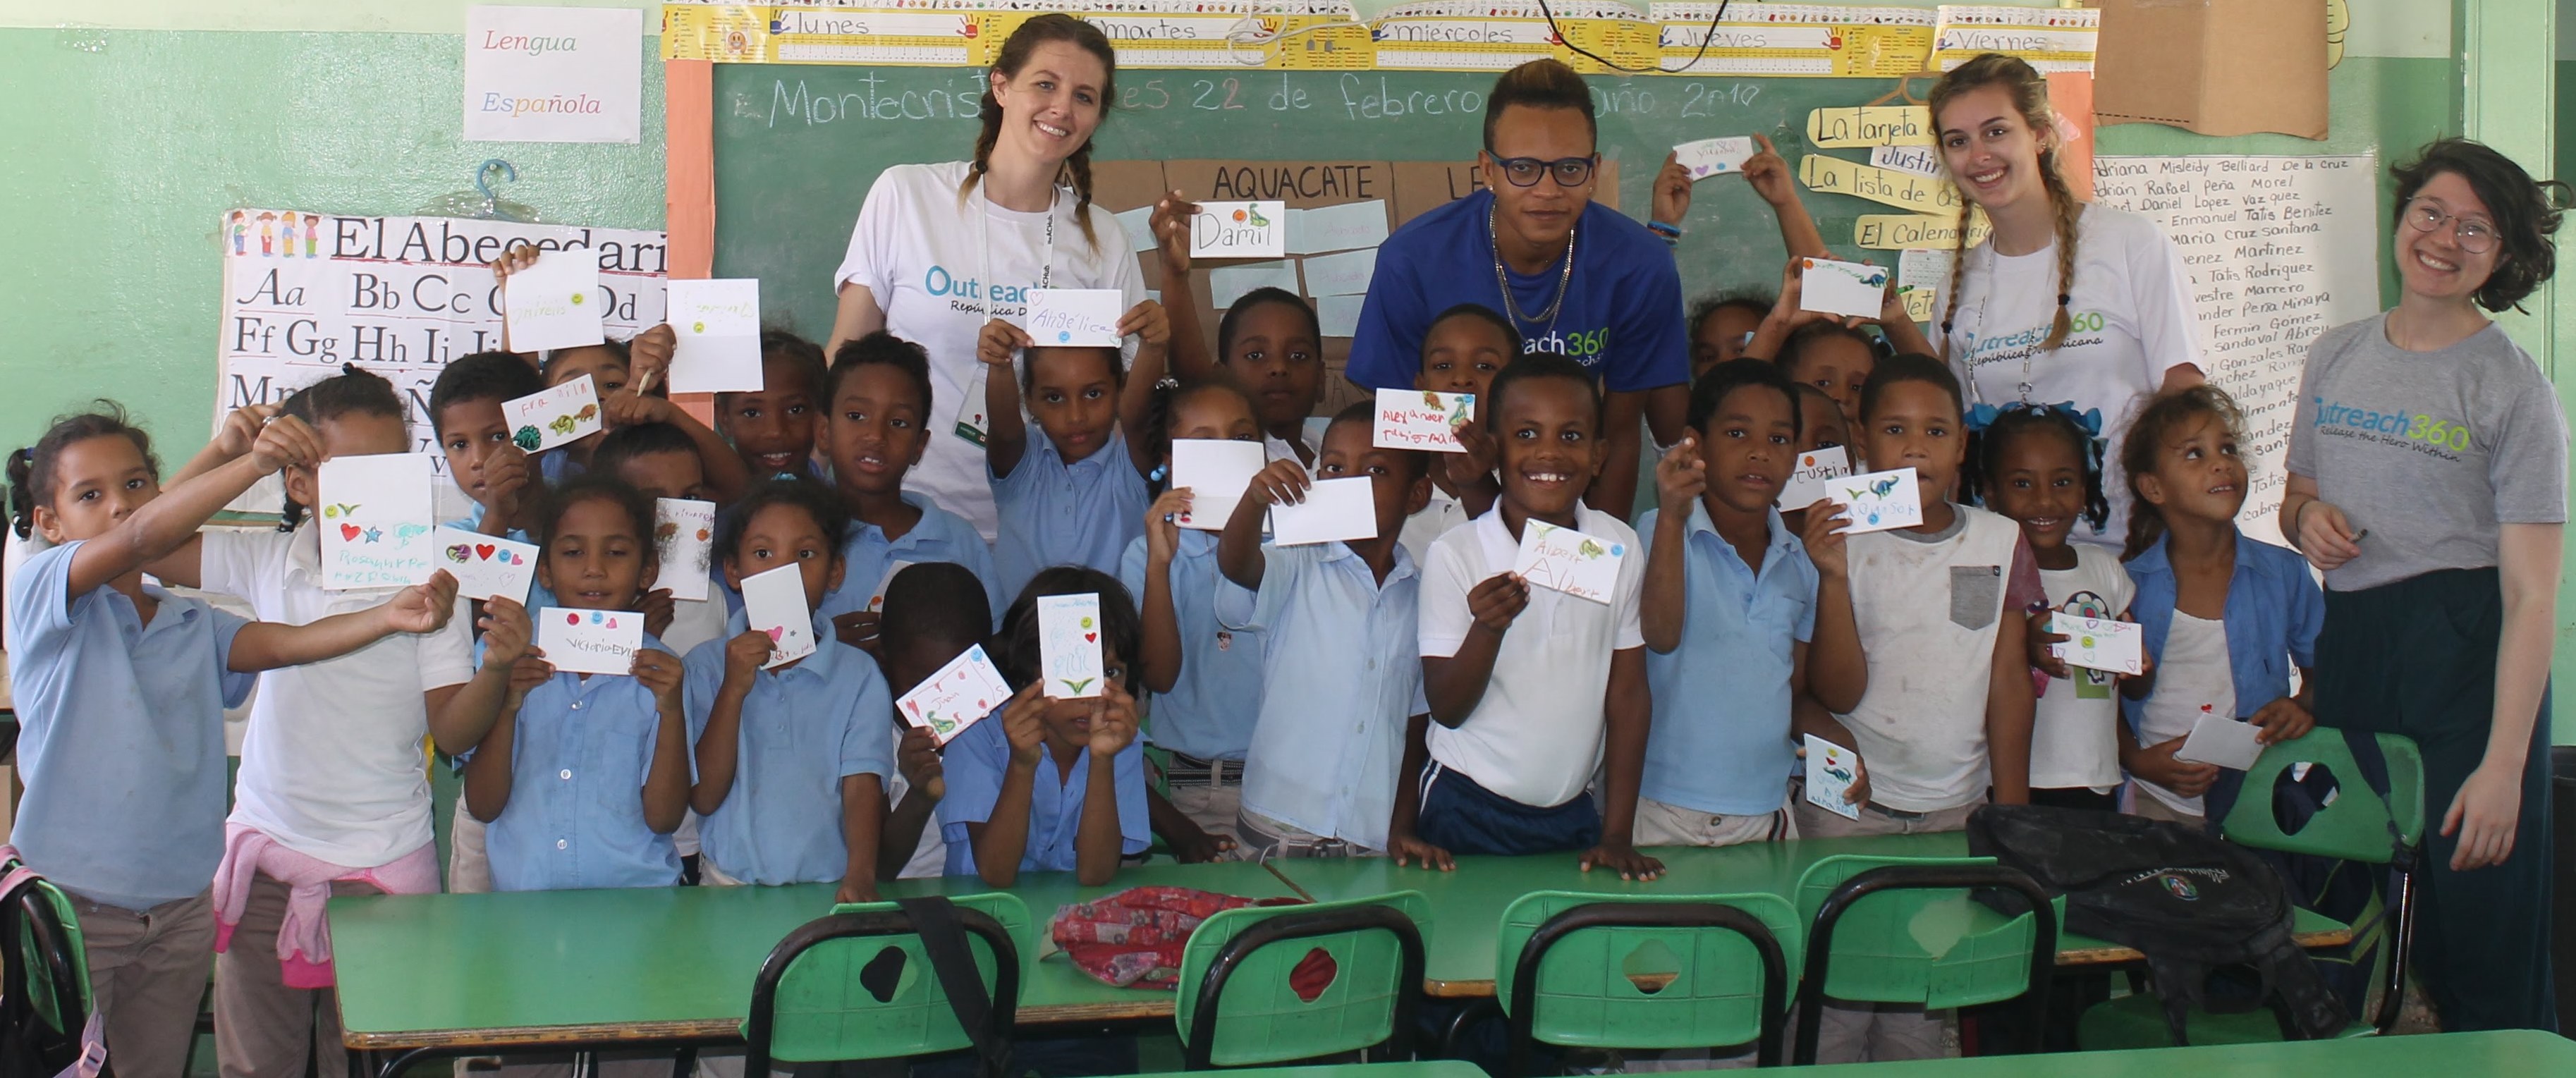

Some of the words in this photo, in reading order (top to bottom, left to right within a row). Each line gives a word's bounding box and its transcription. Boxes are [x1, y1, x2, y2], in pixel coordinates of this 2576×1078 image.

[798, 12, 870, 35] lunes
[1103, 19, 1197, 40] martes
[1396, 20, 1513, 44] miércoles
[482, 30, 578, 56] Lengua
[1957, 30, 2047, 51] Viernes
[480, 91, 602, 118] Española
[1192, 78, 1245, 111] 22
[1269, 73, 1312, 111] de
[1341, 73, 1482, 121] febrero
[1817, 107, 1849, 142] La
[1808, 157, 1838, 190] La
[1853, 167, 1893, 197] lista
[1900, 179, 1927, 203] de
[2159, 159, 2209, 177] Misleidy
[2217, 159, 2269, 173] Belliard
[2144, 179, 2191, 196] Rafael
[2139, 197, 2183, 212] Daniel
[2194, 195, 2232, 212] Lopez
[1198, 212, 1271, 250] Damil
[2171, 210, 2238, 227] Enmanuel
[330, 217, 384, 260] El
[1860, 221, 1883, 247] El
[1892, 221, 1992, 245] Calendrio
[2233, 240, 2305, 259] Martinez
[2245, 262, 2315, 282] Rodriguez
[236, 267, 307, 307] Aa
[352, 273, 401, 312] Bb
[410, 274, 472, 315] Cc
[2244, 283, 2305, 298] Marrero
[950, 299, 1015, 316] Repúlica
[233, 316, 277, 355] Ff
[286, 318, 338, 365] Gg
[350, 326, 409, 364] Hh
[422, 328, 450, 365] Ii
[1522, 326, 1610, 357] ach360
[2028, 336, 2104, 356] Domnicana
[2314, 396, 2470, 453] utreach360
[2320, 425, 2357, 439] Release
[2357, 431, 2377, 443] the
[2380, 434, 2410, 448] Hero
[2412, 441, 2462, 463] Within
